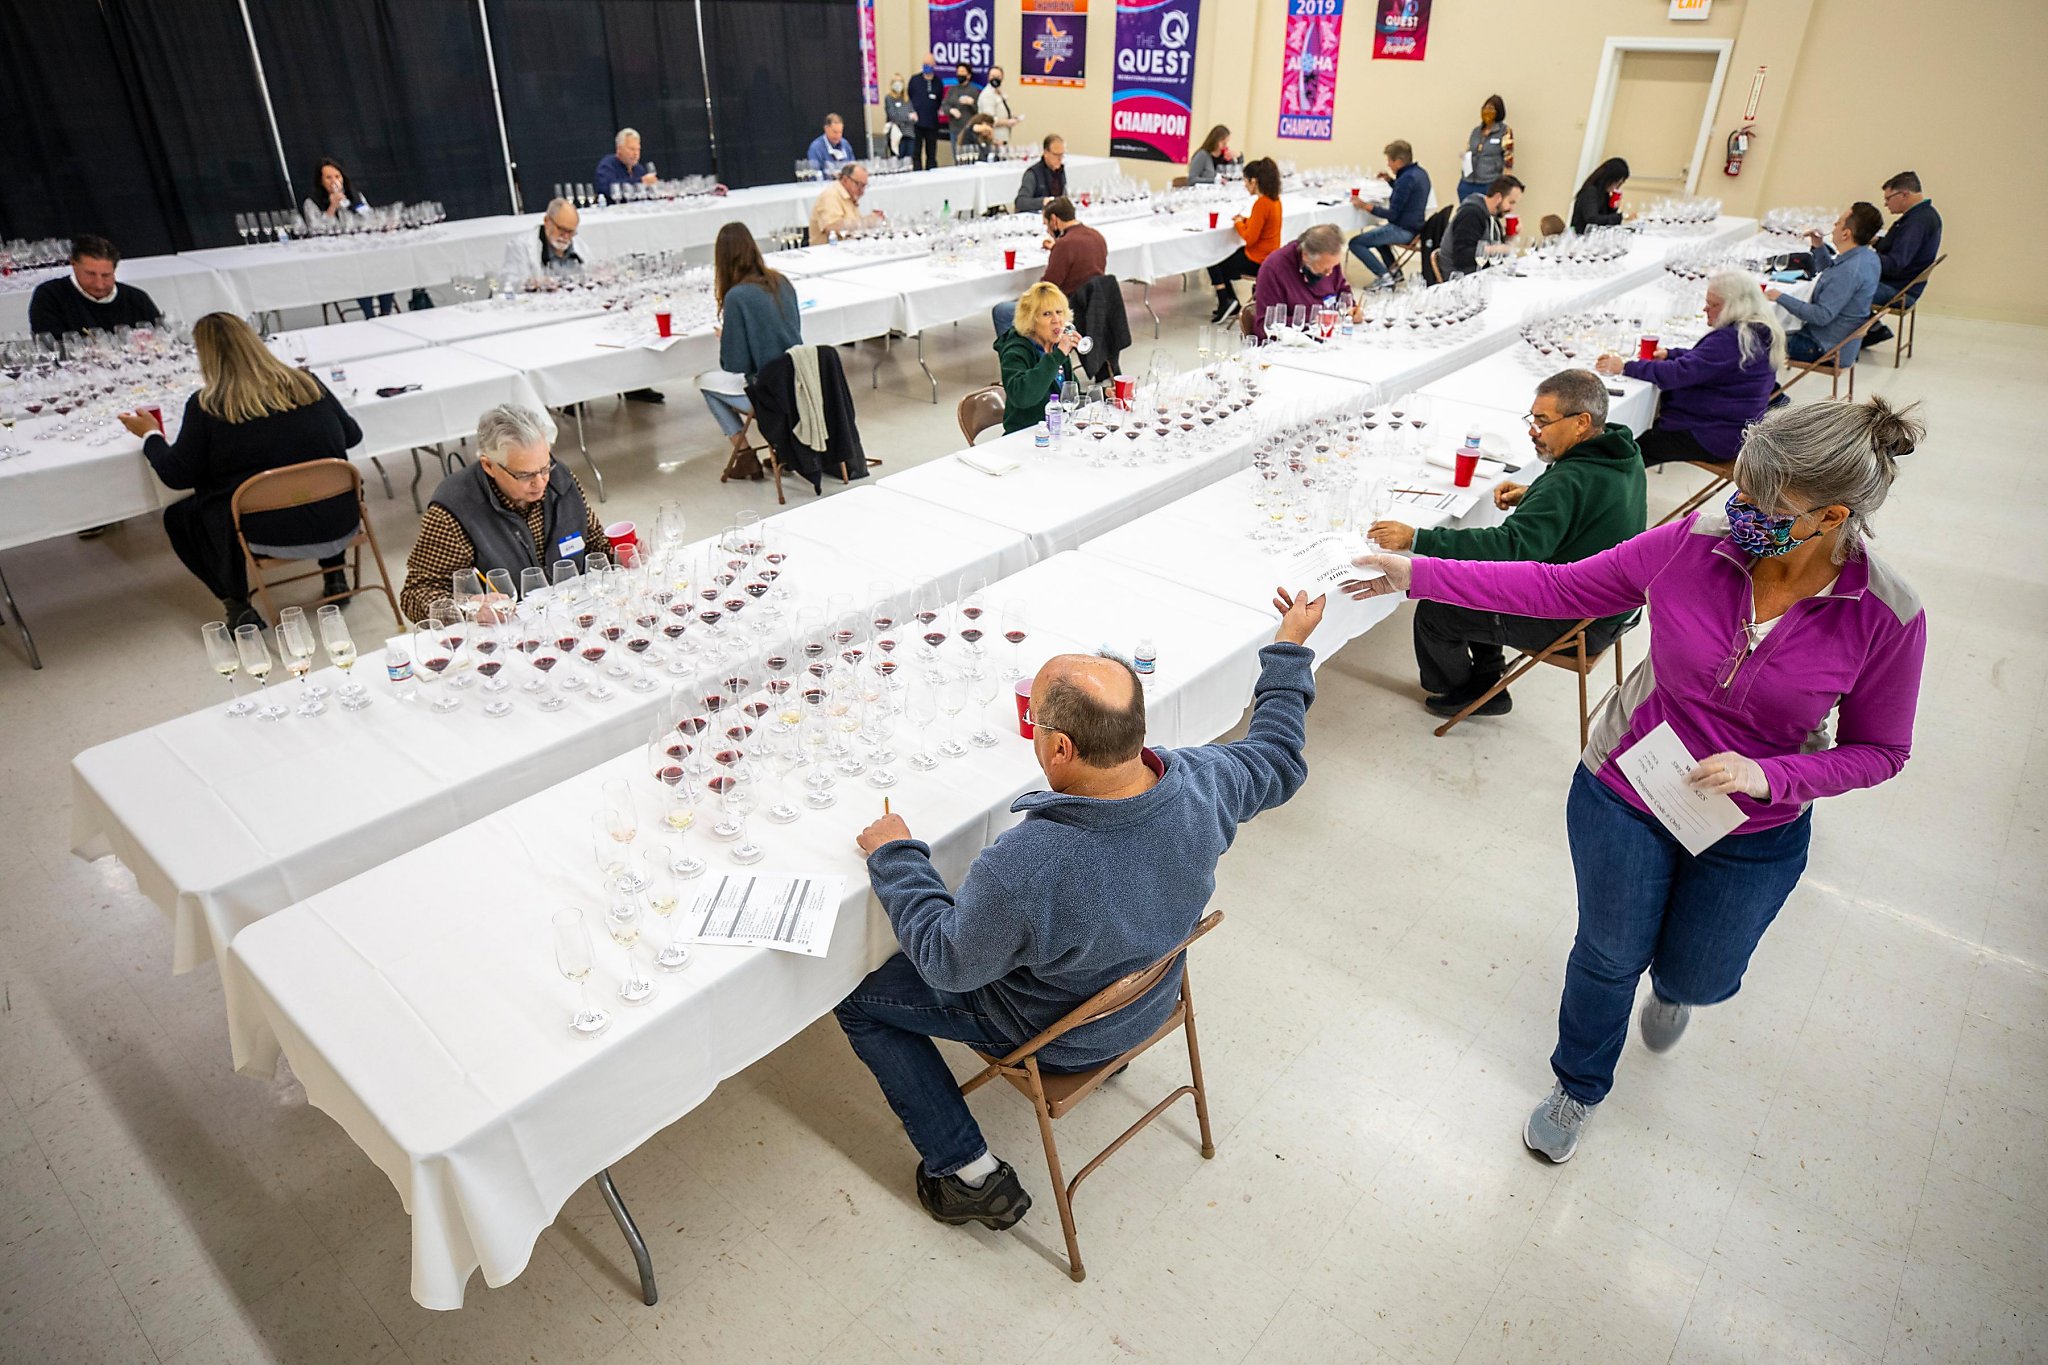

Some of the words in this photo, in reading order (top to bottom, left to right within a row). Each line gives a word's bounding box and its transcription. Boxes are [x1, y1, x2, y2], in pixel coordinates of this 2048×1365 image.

[1295, 0, 1336, 15] 2019
[1385, 15, 1419, 28] QUEST
[933, 42, 991, 65] QUEST
[1117, 48, 1192, 76] QUEST
[1113, 110, 1187, 137] CHAMPION
[1280, 116, 1331, 138] CHAMPIONS
[1636, 776, 1655, 801] Designate
[1654, 798, 1666, 814] Code
[1670, 818, 1682, 831] Only
